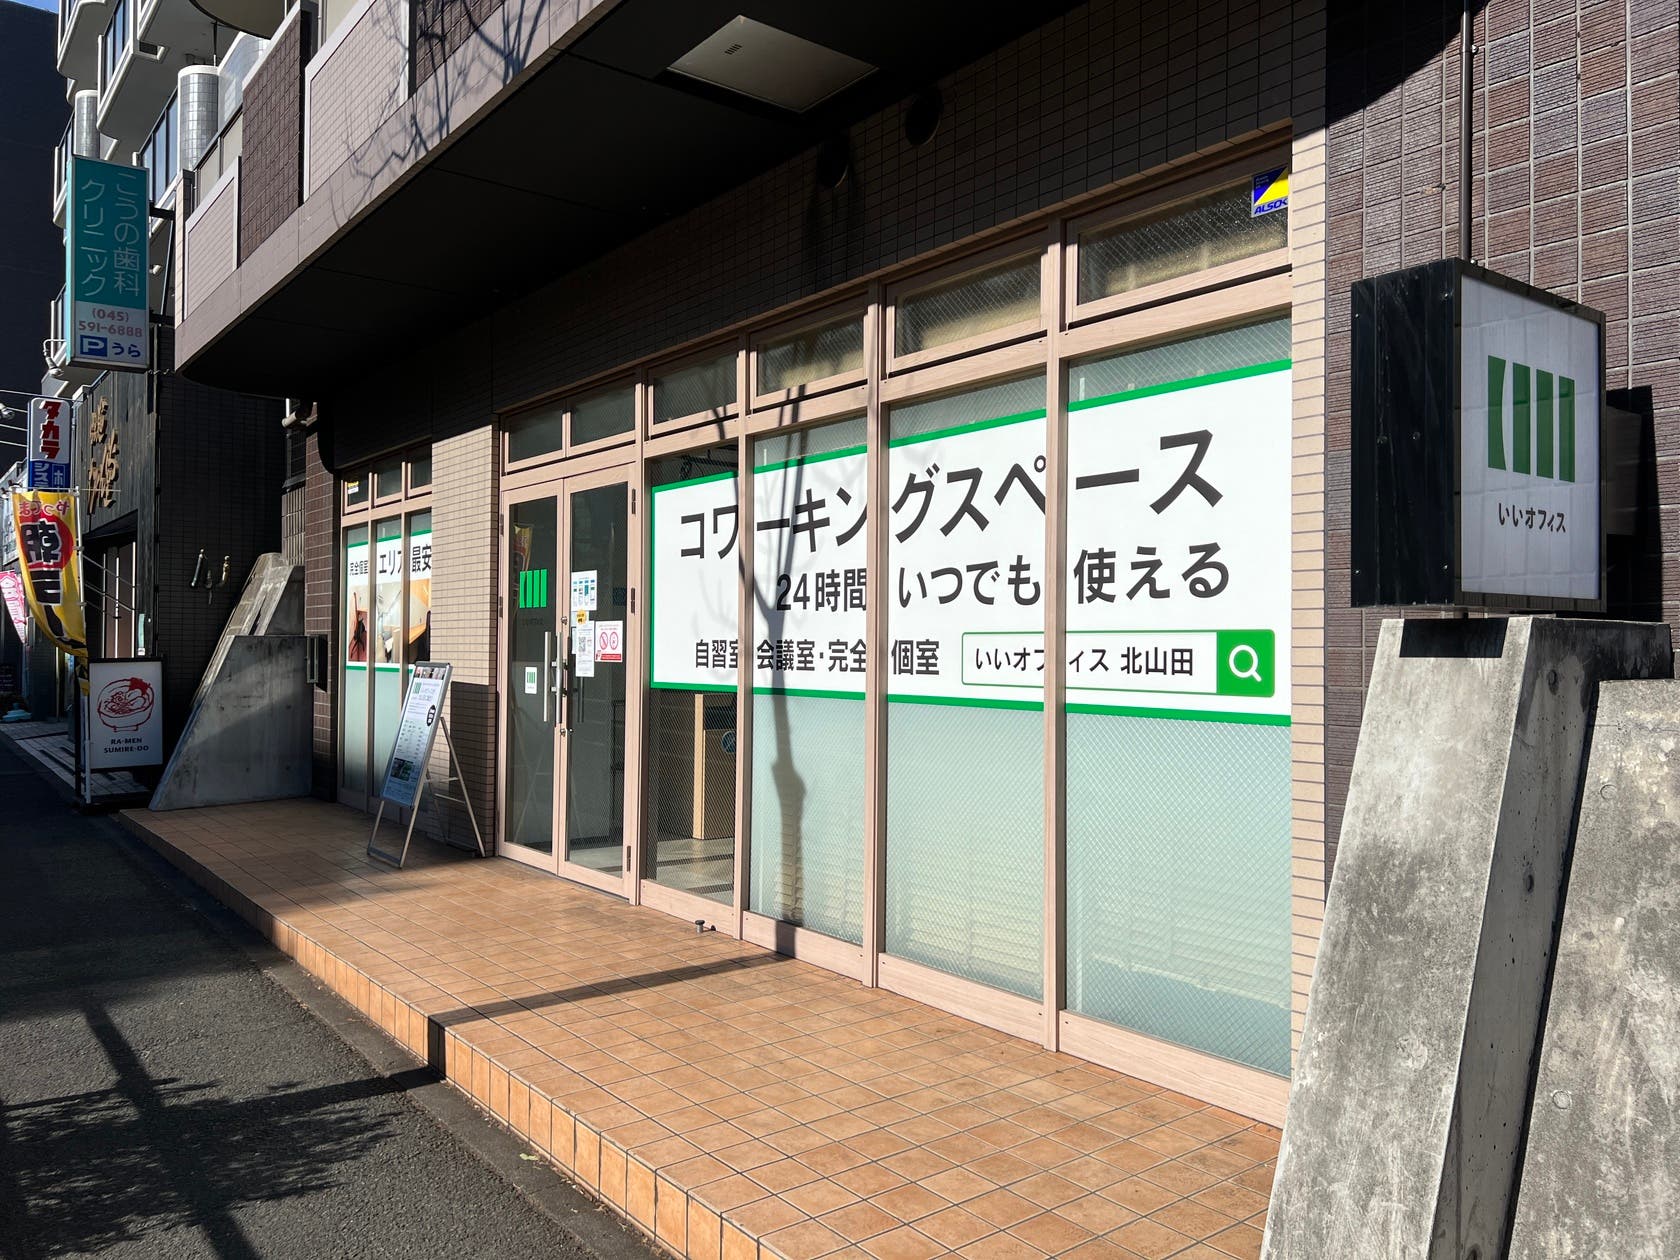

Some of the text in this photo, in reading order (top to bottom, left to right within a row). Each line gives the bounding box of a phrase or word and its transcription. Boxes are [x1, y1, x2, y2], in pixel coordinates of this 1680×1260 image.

[80, 179, 107, 297] クリニック
[113, 172, 140, 297] こうの歯科
[78, 320, 143, 338] 591-6888
[92, 307, 129, 323] (045)
[112, 342, 141, 358] うら
[39, 400, 62, 459] タカラ
[681, 429, 1223, 560] コワーキングスペース
[1498, 502, 1566, 533] いいオフィス
[975, 646, 1193, 676] いいオフィス 北山田
